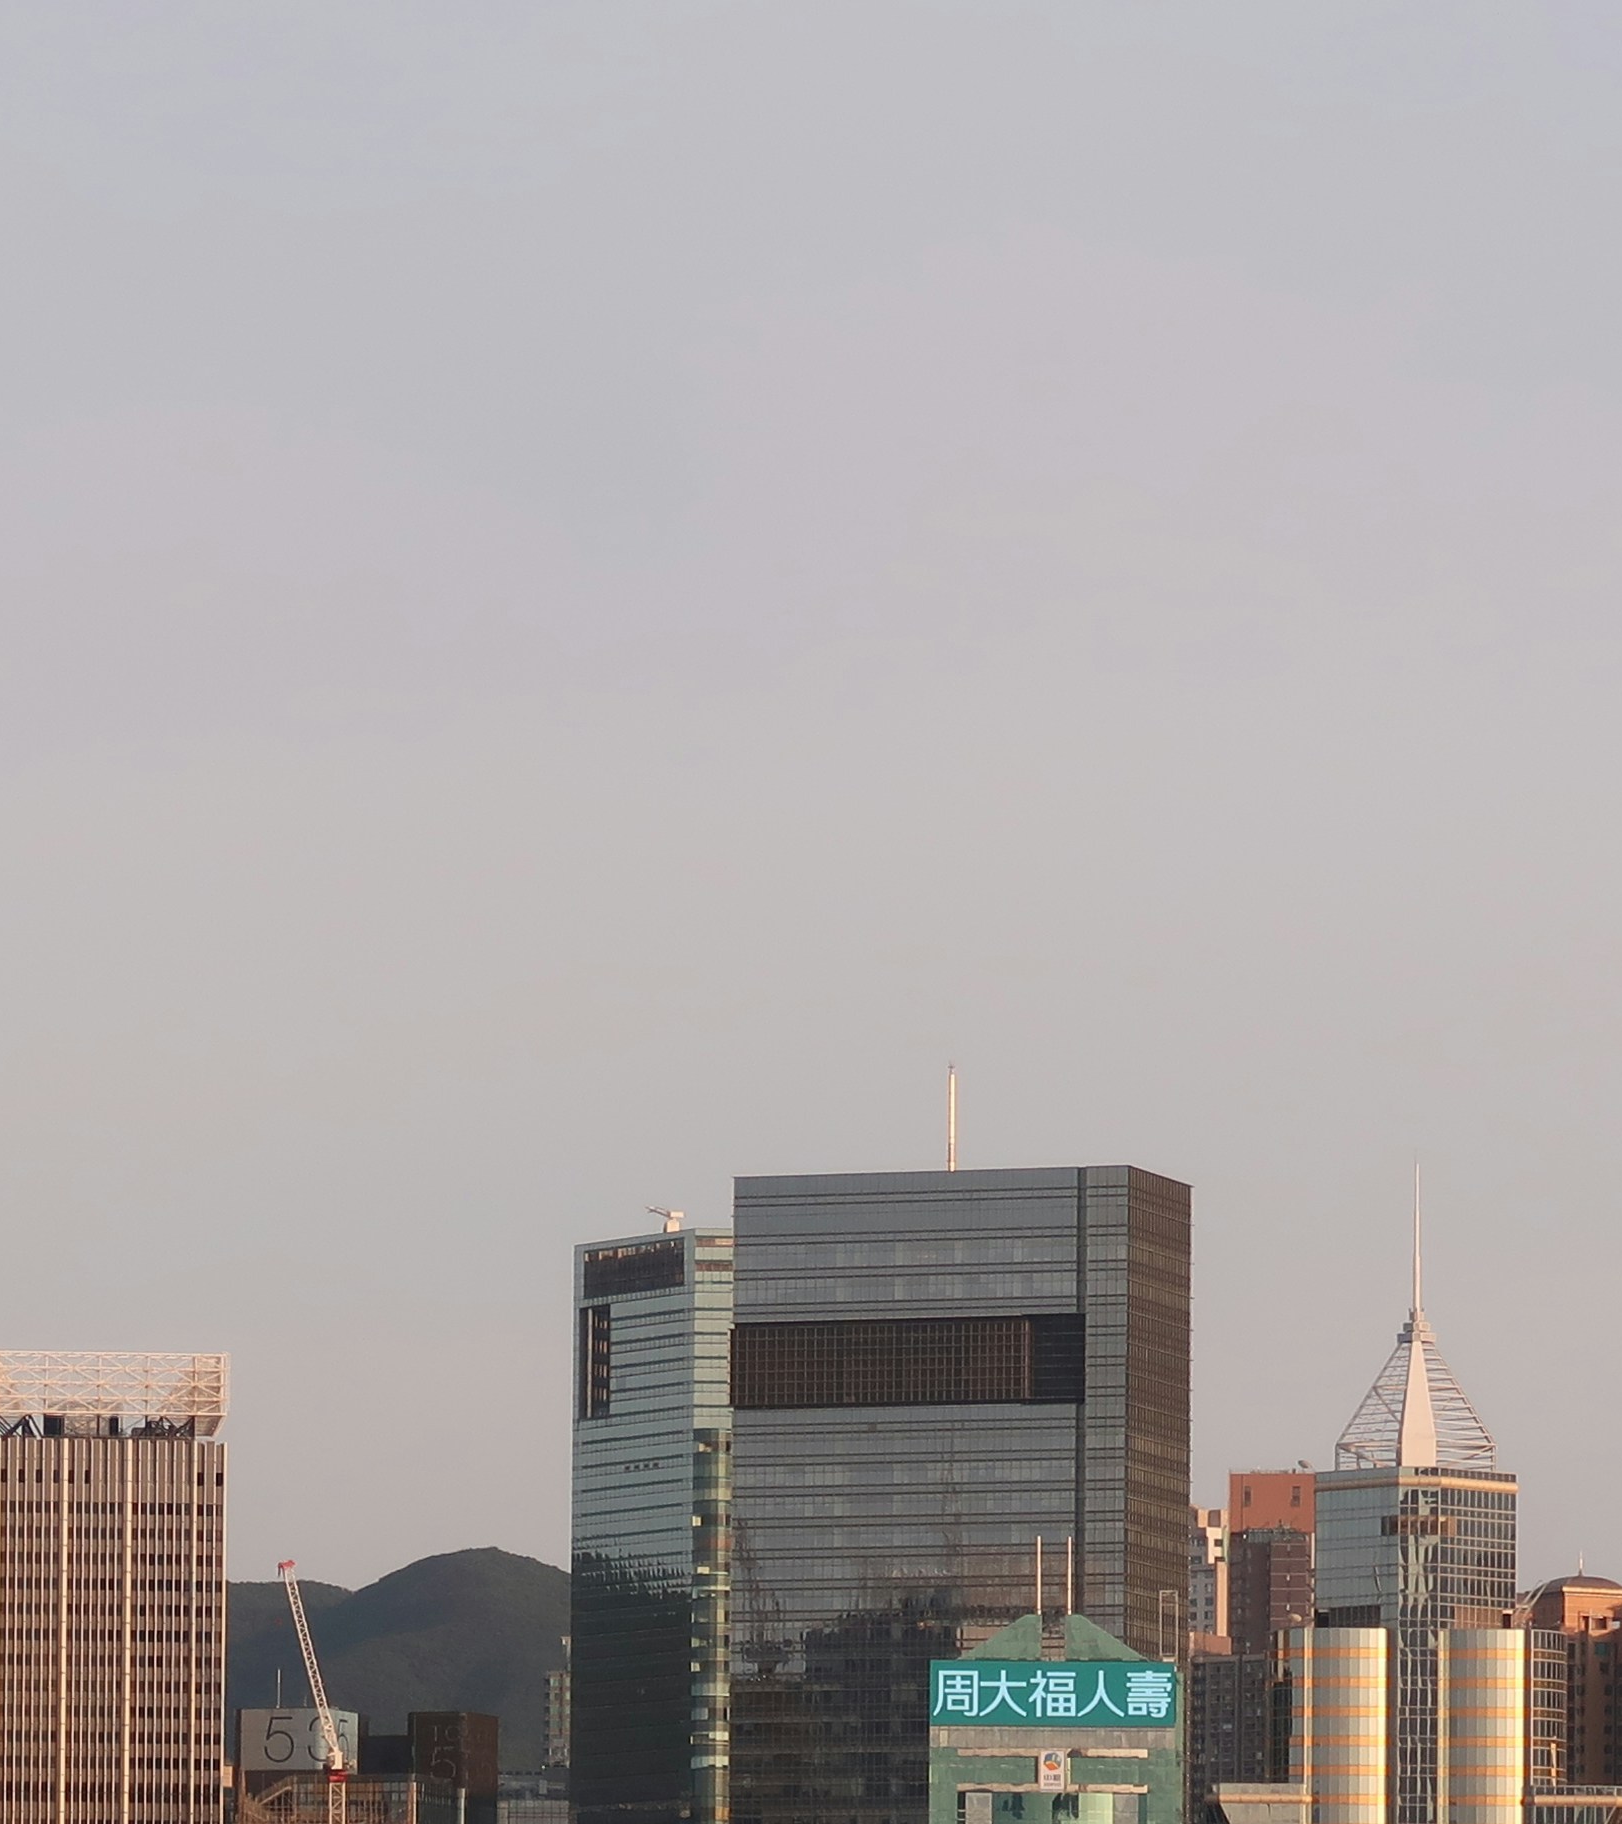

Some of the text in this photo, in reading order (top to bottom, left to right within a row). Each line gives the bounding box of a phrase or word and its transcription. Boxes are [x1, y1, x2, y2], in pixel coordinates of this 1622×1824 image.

[933, 1669, 1172, 1718] 周大福人壽
